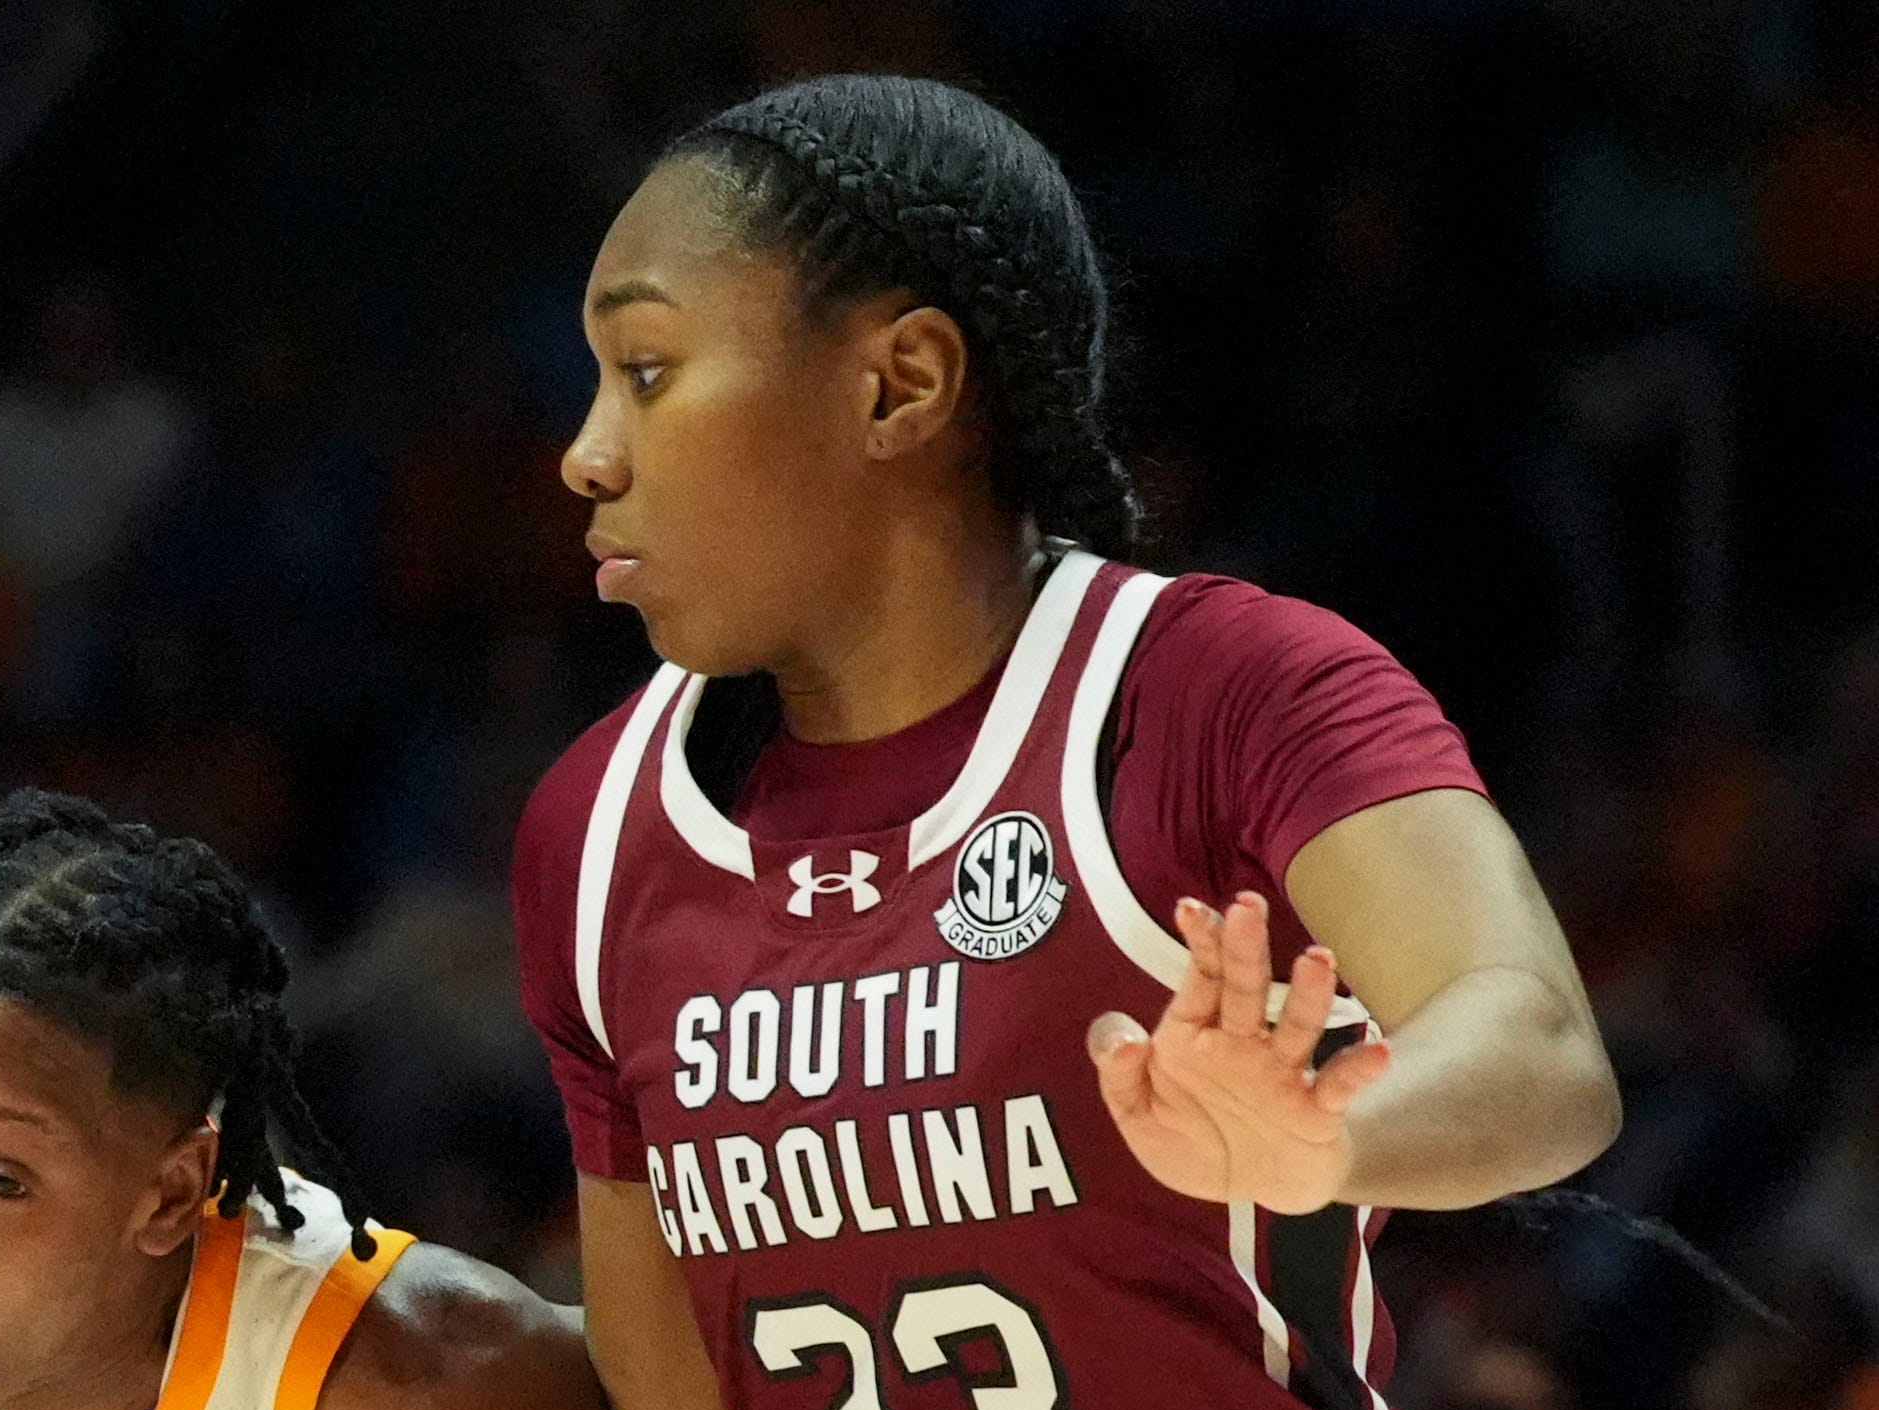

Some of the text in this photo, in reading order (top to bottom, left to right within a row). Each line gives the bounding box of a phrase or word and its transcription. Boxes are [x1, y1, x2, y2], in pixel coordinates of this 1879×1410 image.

[948, 911, 1050, 956] GRADUATE
[963, 819, 1047, 922] SEC
[673, 960, 962, 1109] SOUTH
[646, 1093, 1079, 1257] CAROLINA
